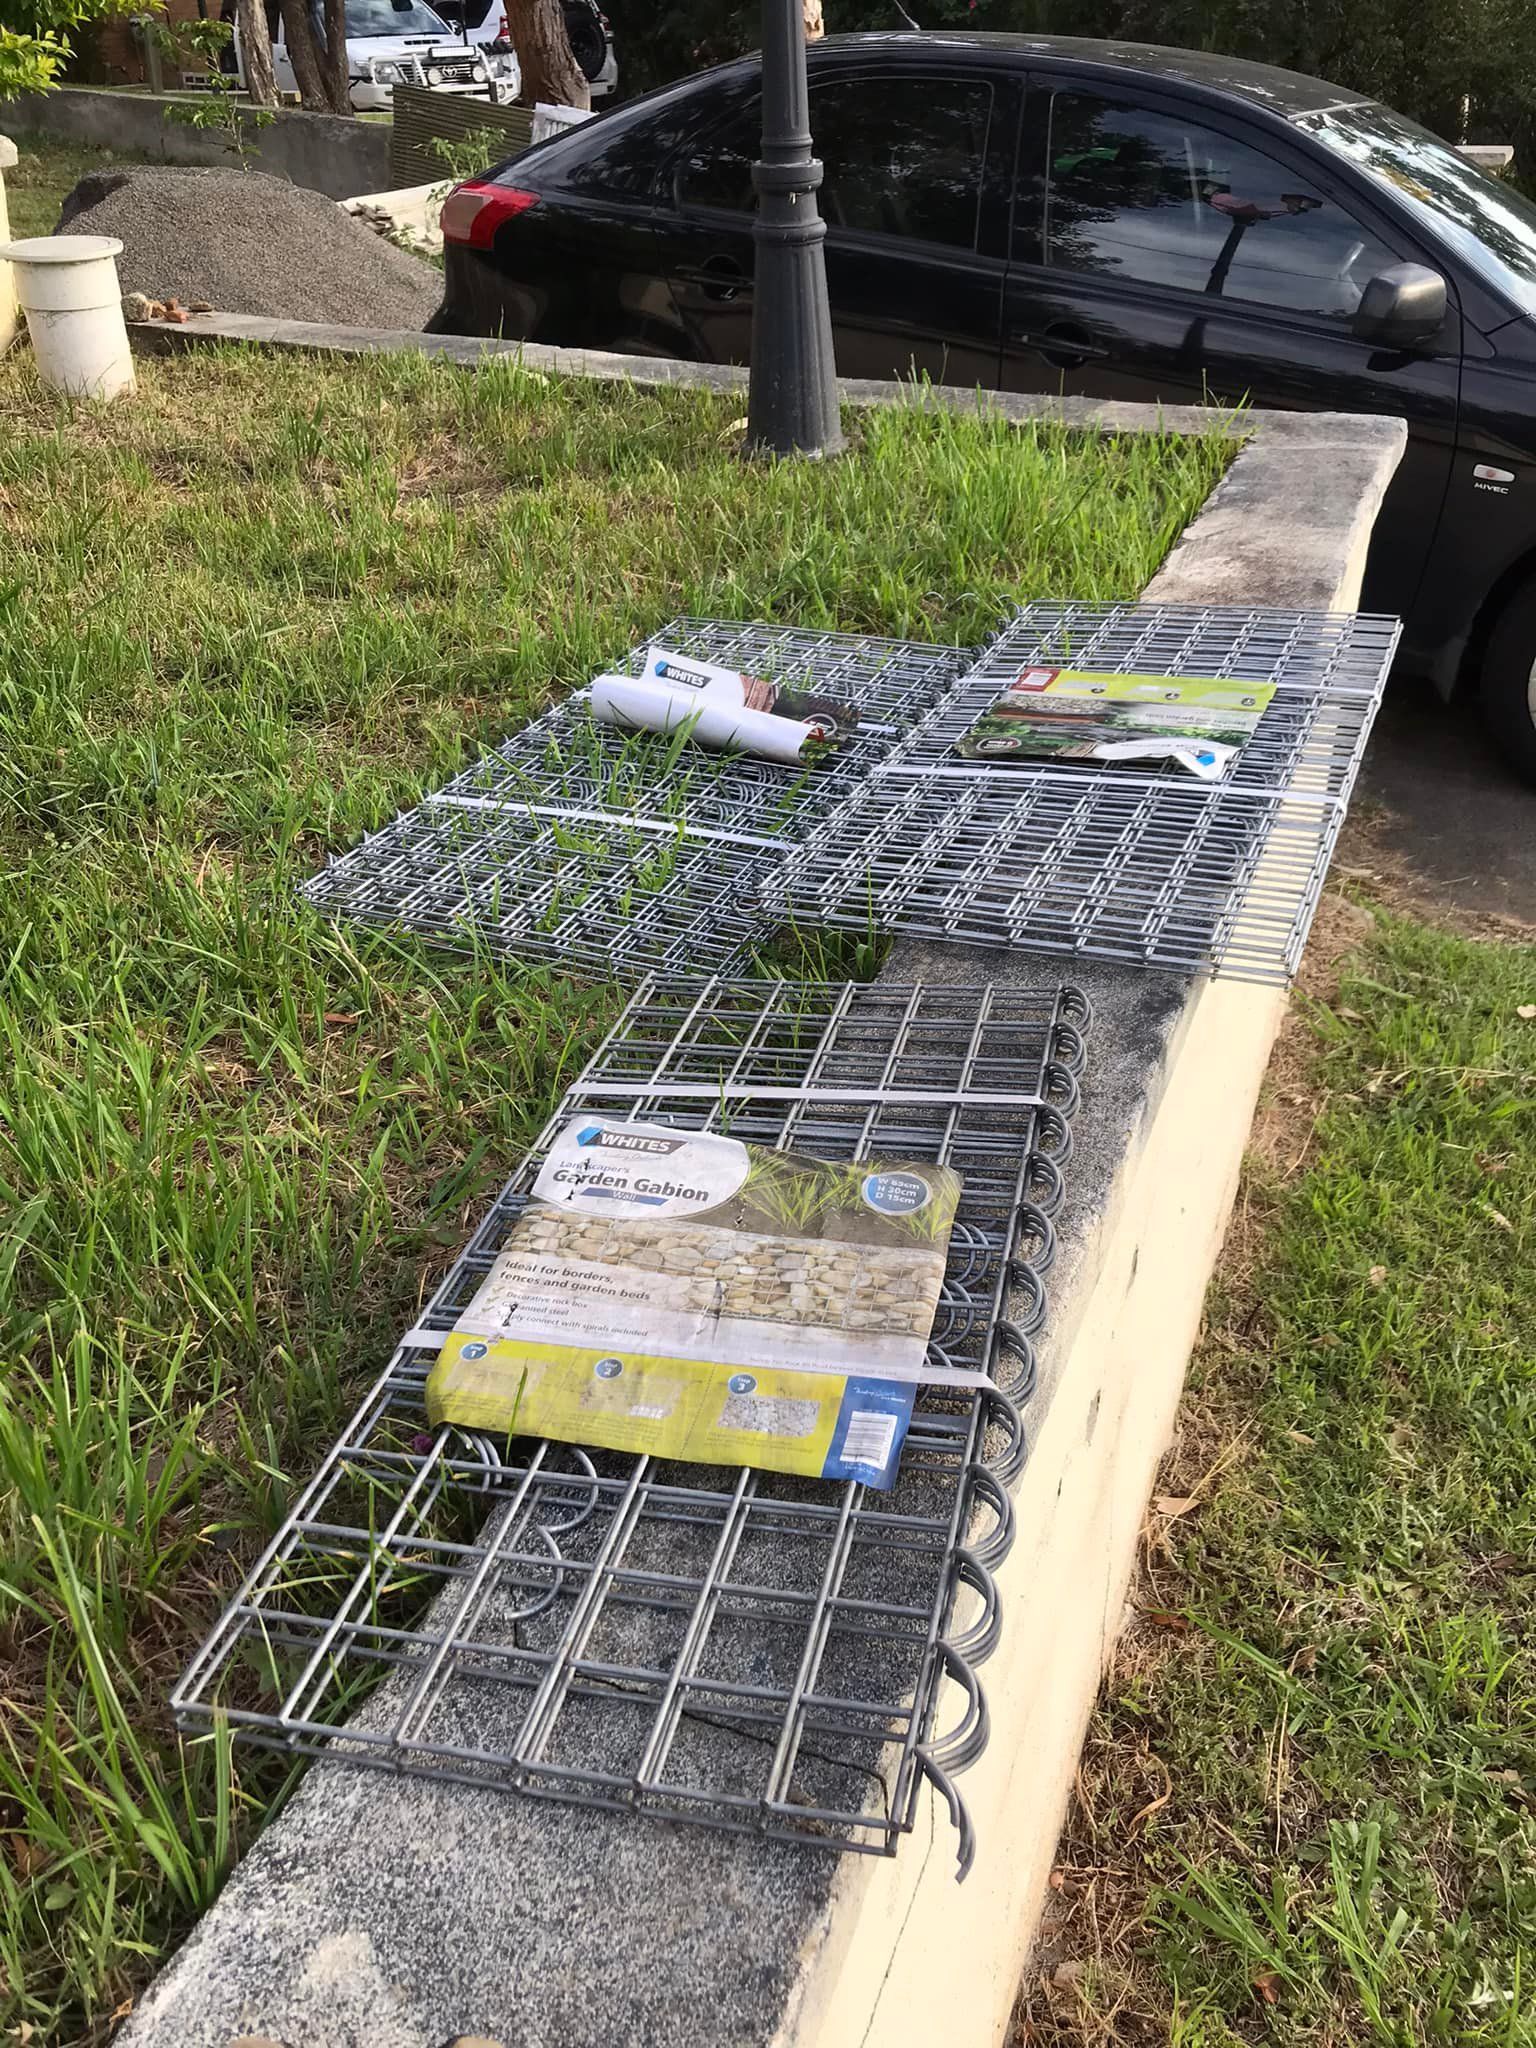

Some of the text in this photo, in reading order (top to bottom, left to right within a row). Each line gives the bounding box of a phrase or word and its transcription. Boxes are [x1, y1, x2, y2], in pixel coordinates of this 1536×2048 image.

[1474, 482, 1509, 494] MIVEC
[667, 667, 705, 687] WHITES
[600, 1132, 671, 1152] WHITES
[553, 1169, 709, 1201] Garden Gabion
[887, 1186, 917, 1197] 30cm
[887, 1194, 916, 1204] 15cm
[505, 1260, 614, 1284] Ideal for borders,
[500, 1270, 651, 1300] fences and garden beds
[506, 1291, 588, 1309] Decorative rock box
[549, 1307, 570, 1316] steel
[526, 1315, 559, 1326] connect
[561, 1319, 581, 1329] with
[582, 1323, 610, 1334] spirals
[611, 1325, 649, 1337] included
